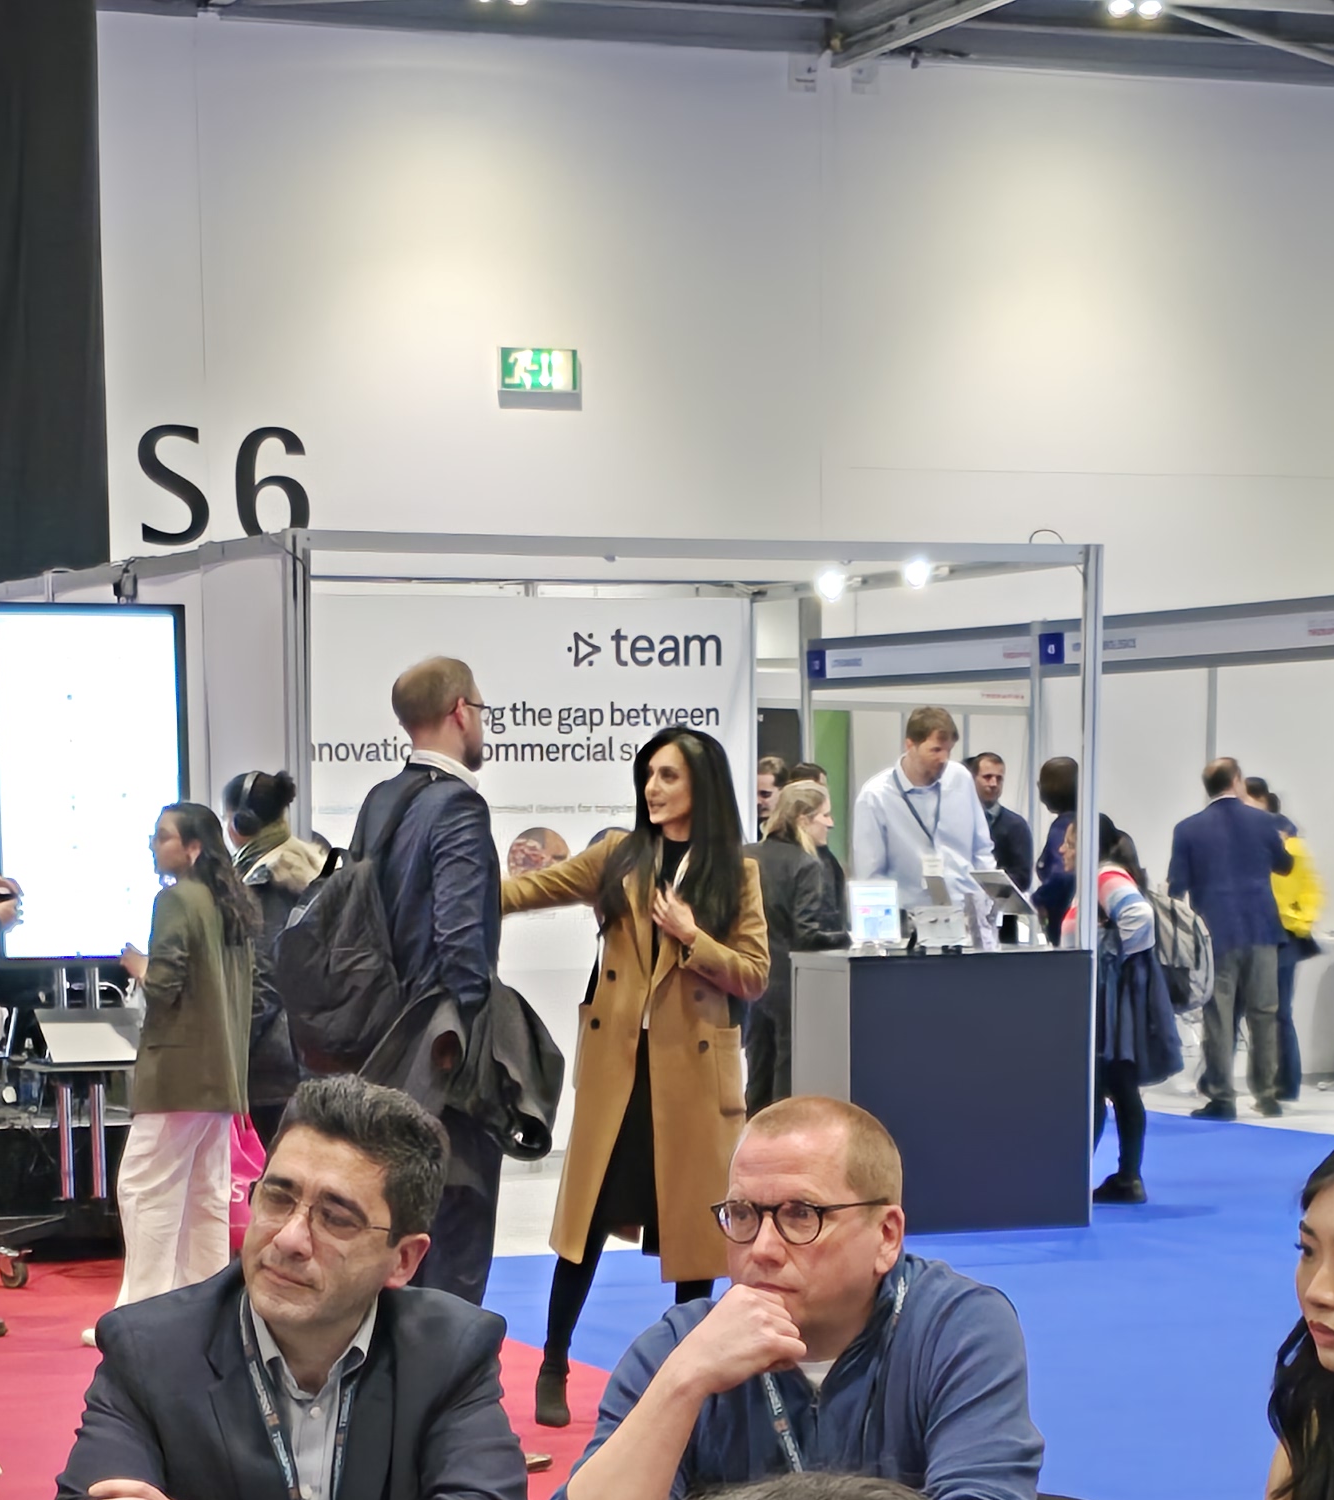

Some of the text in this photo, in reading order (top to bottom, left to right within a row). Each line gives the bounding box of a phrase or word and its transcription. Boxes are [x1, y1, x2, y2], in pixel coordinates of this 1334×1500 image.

[611, 628, 723, 667] team
[509, 701, 552, 726] the
[557, 706, 604, 734] gap
[610, 701, 719, 726] between
[481, 736, 615, 762] ommercial
